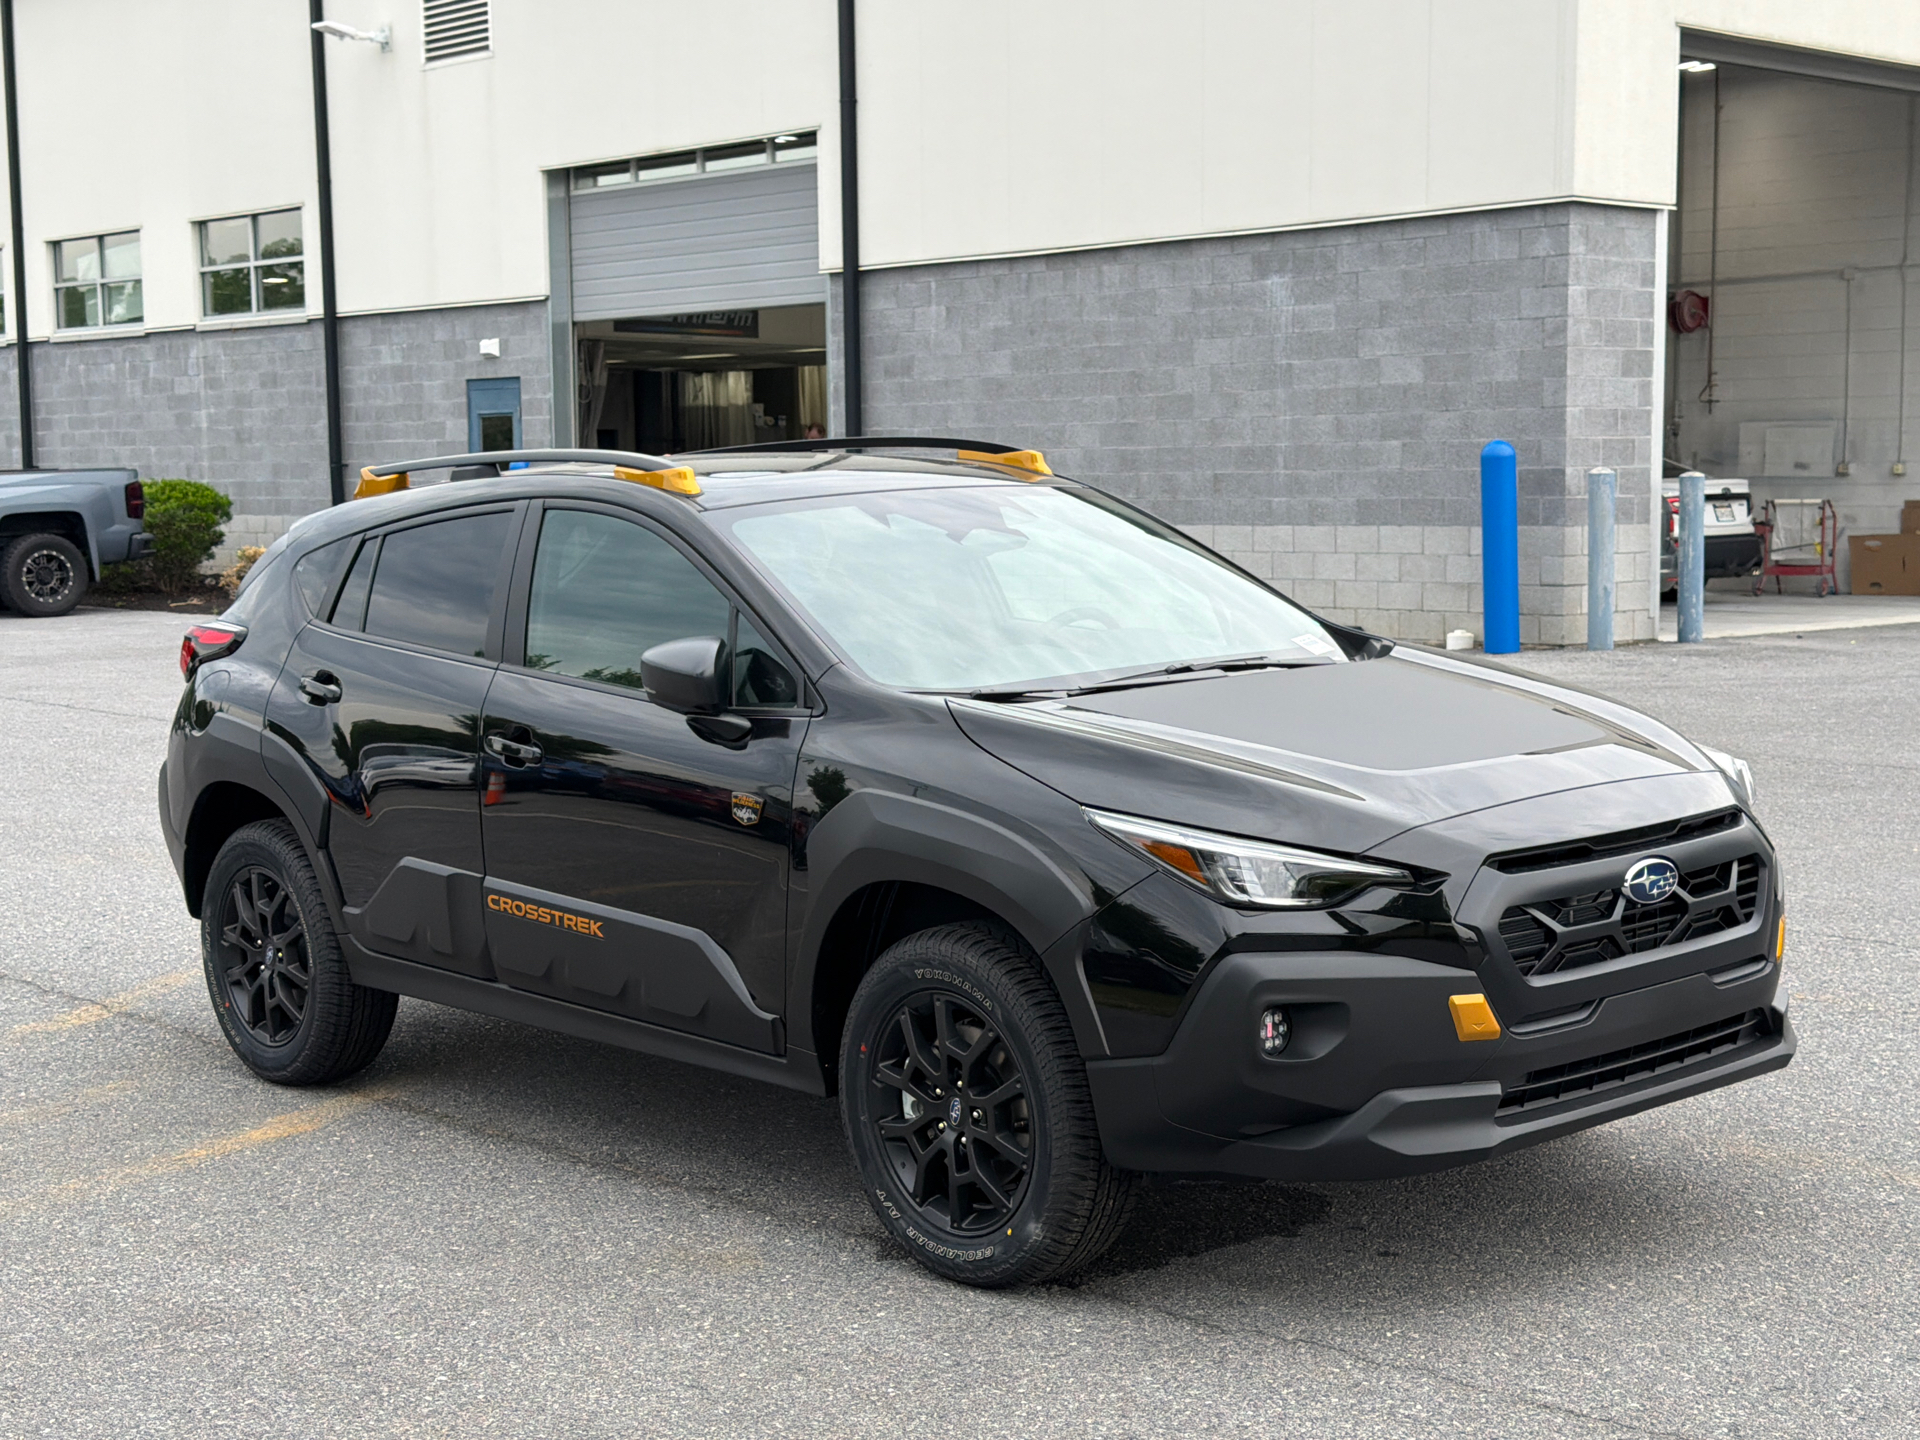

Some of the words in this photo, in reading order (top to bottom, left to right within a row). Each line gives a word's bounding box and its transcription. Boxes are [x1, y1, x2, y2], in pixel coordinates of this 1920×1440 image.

[487, 894, 605, 938] CROSSTREK
[914, 968, 993, 1011] YOKOHAMA
[875, 1189, 901, 1219] A/T
[905, 1226, 994, 1262] GEOLANDAR
